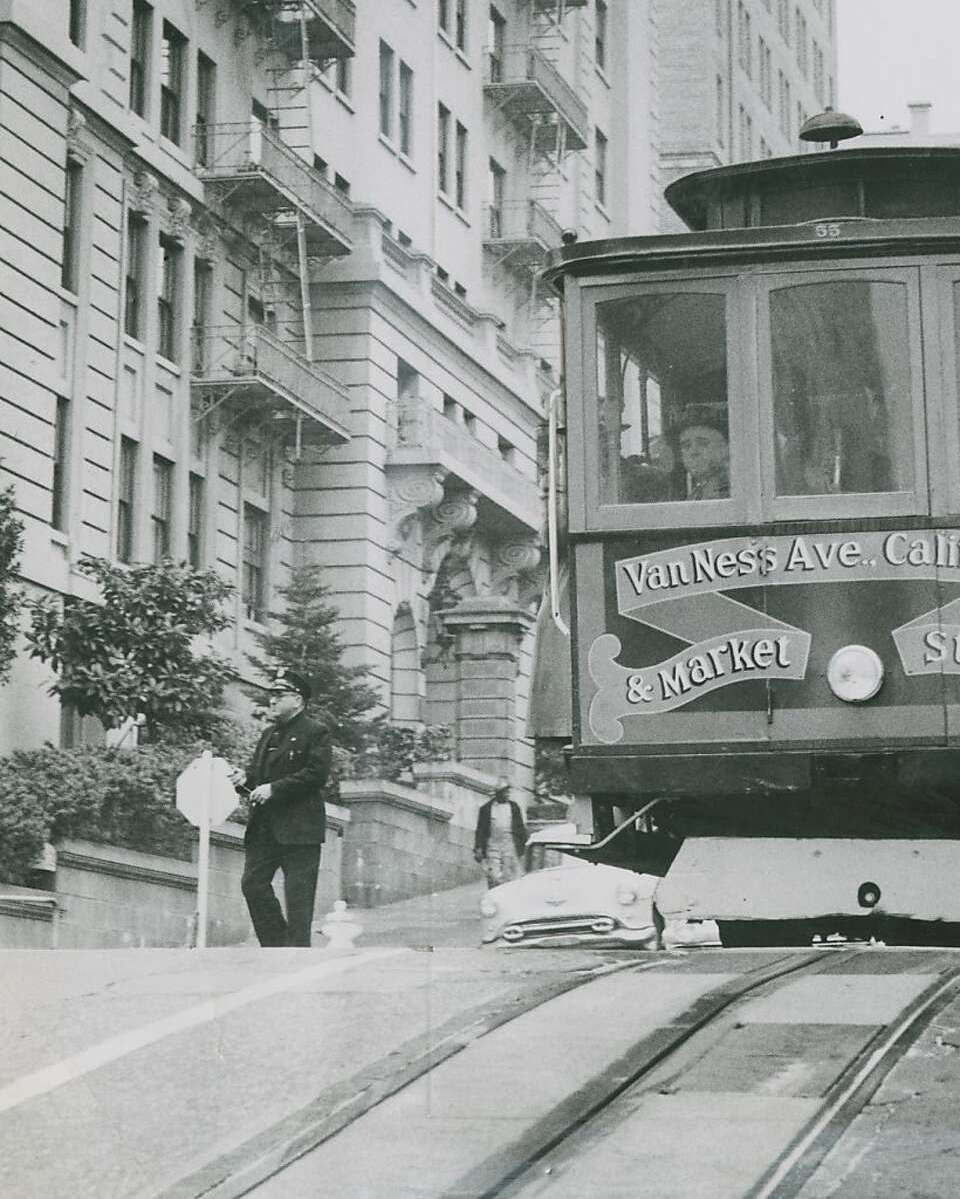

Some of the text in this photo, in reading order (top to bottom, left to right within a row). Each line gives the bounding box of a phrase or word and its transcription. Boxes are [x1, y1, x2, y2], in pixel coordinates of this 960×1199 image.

[816, 224, 840, 237] 55
[622, 558, 690, 596] Van
[690, 546, 778, 584] Ness
[626, 635, 792, 704] & Market
